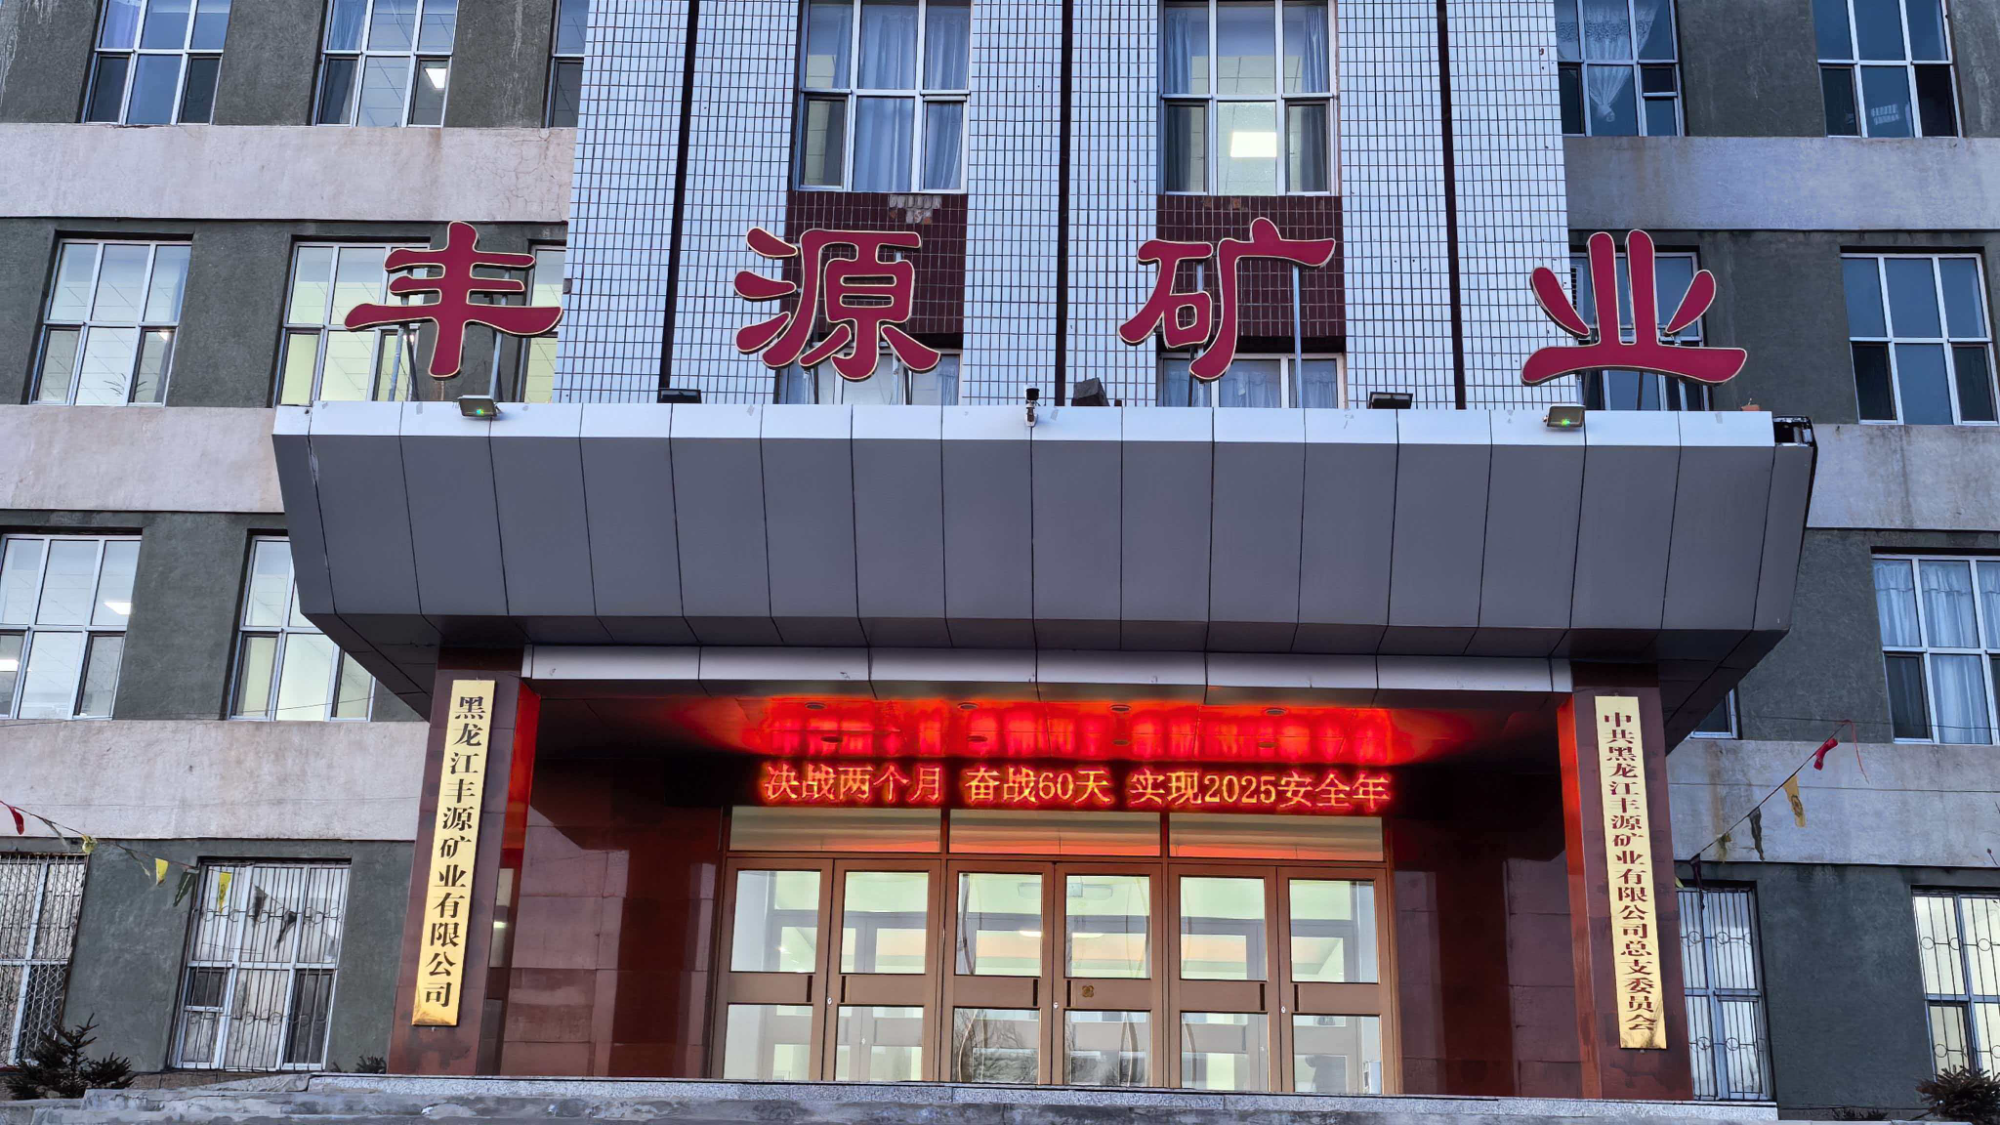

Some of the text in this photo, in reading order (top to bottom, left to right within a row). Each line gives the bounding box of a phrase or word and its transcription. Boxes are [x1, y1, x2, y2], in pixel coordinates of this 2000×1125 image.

[344, 216, 1748, 387] 丰源矿业
[424, 696, 486, 1008] 黑龙江丰源矿业有限公司
[764, 763, 1391, 809] 决战两个月 奋战60天 实现2025安全年
[1604, 712, 1657, 1031] 中共黑龙江丰源矿业有限公司总支委员会
